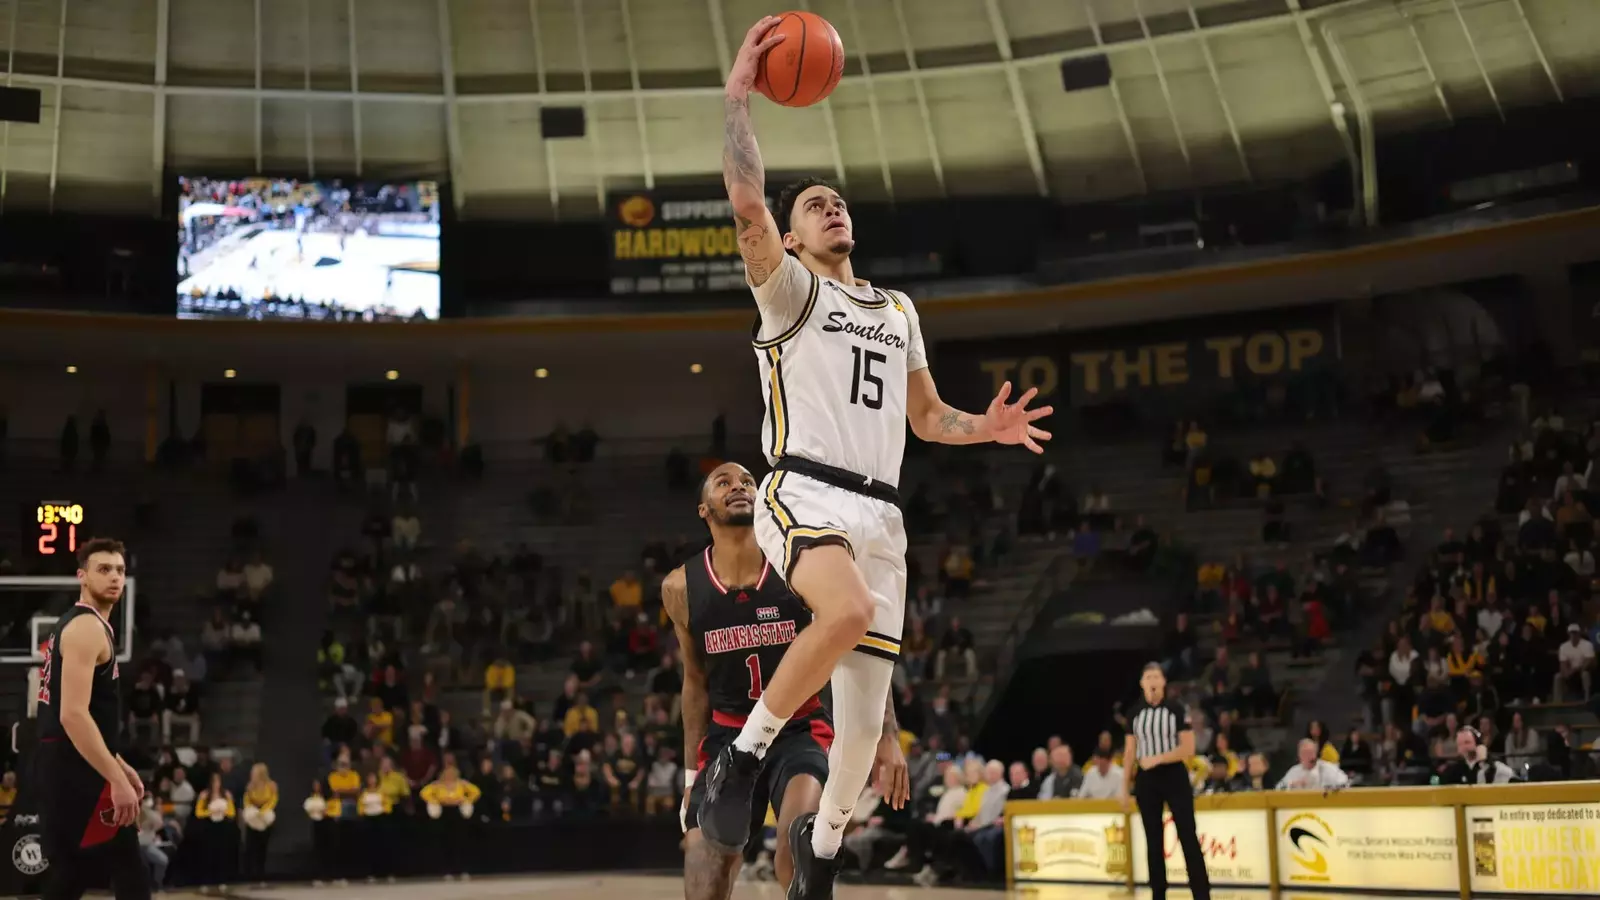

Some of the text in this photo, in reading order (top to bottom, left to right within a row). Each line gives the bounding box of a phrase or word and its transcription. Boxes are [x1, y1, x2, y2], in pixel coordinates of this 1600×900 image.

[822, 311, 906, 352] Southern
[849, 345, 887, 411] 15
[980, 329, 1323, 396] TO THE TOP
[37, 504, 84, 525] 13:40
[38, 523, 76, 554] 21
[756, 606, 780, 620] SBC
[704, 619, 797, 654] ARKANSAS STATE
[745, 653, 764, 700] 1
[1532, 811, 1546, 823] app
[1547, 807, 1584, 820] dedicated
[1585, 807, 1594, 820] to
[1501, 825, 1597, 853] SOUTHERN
